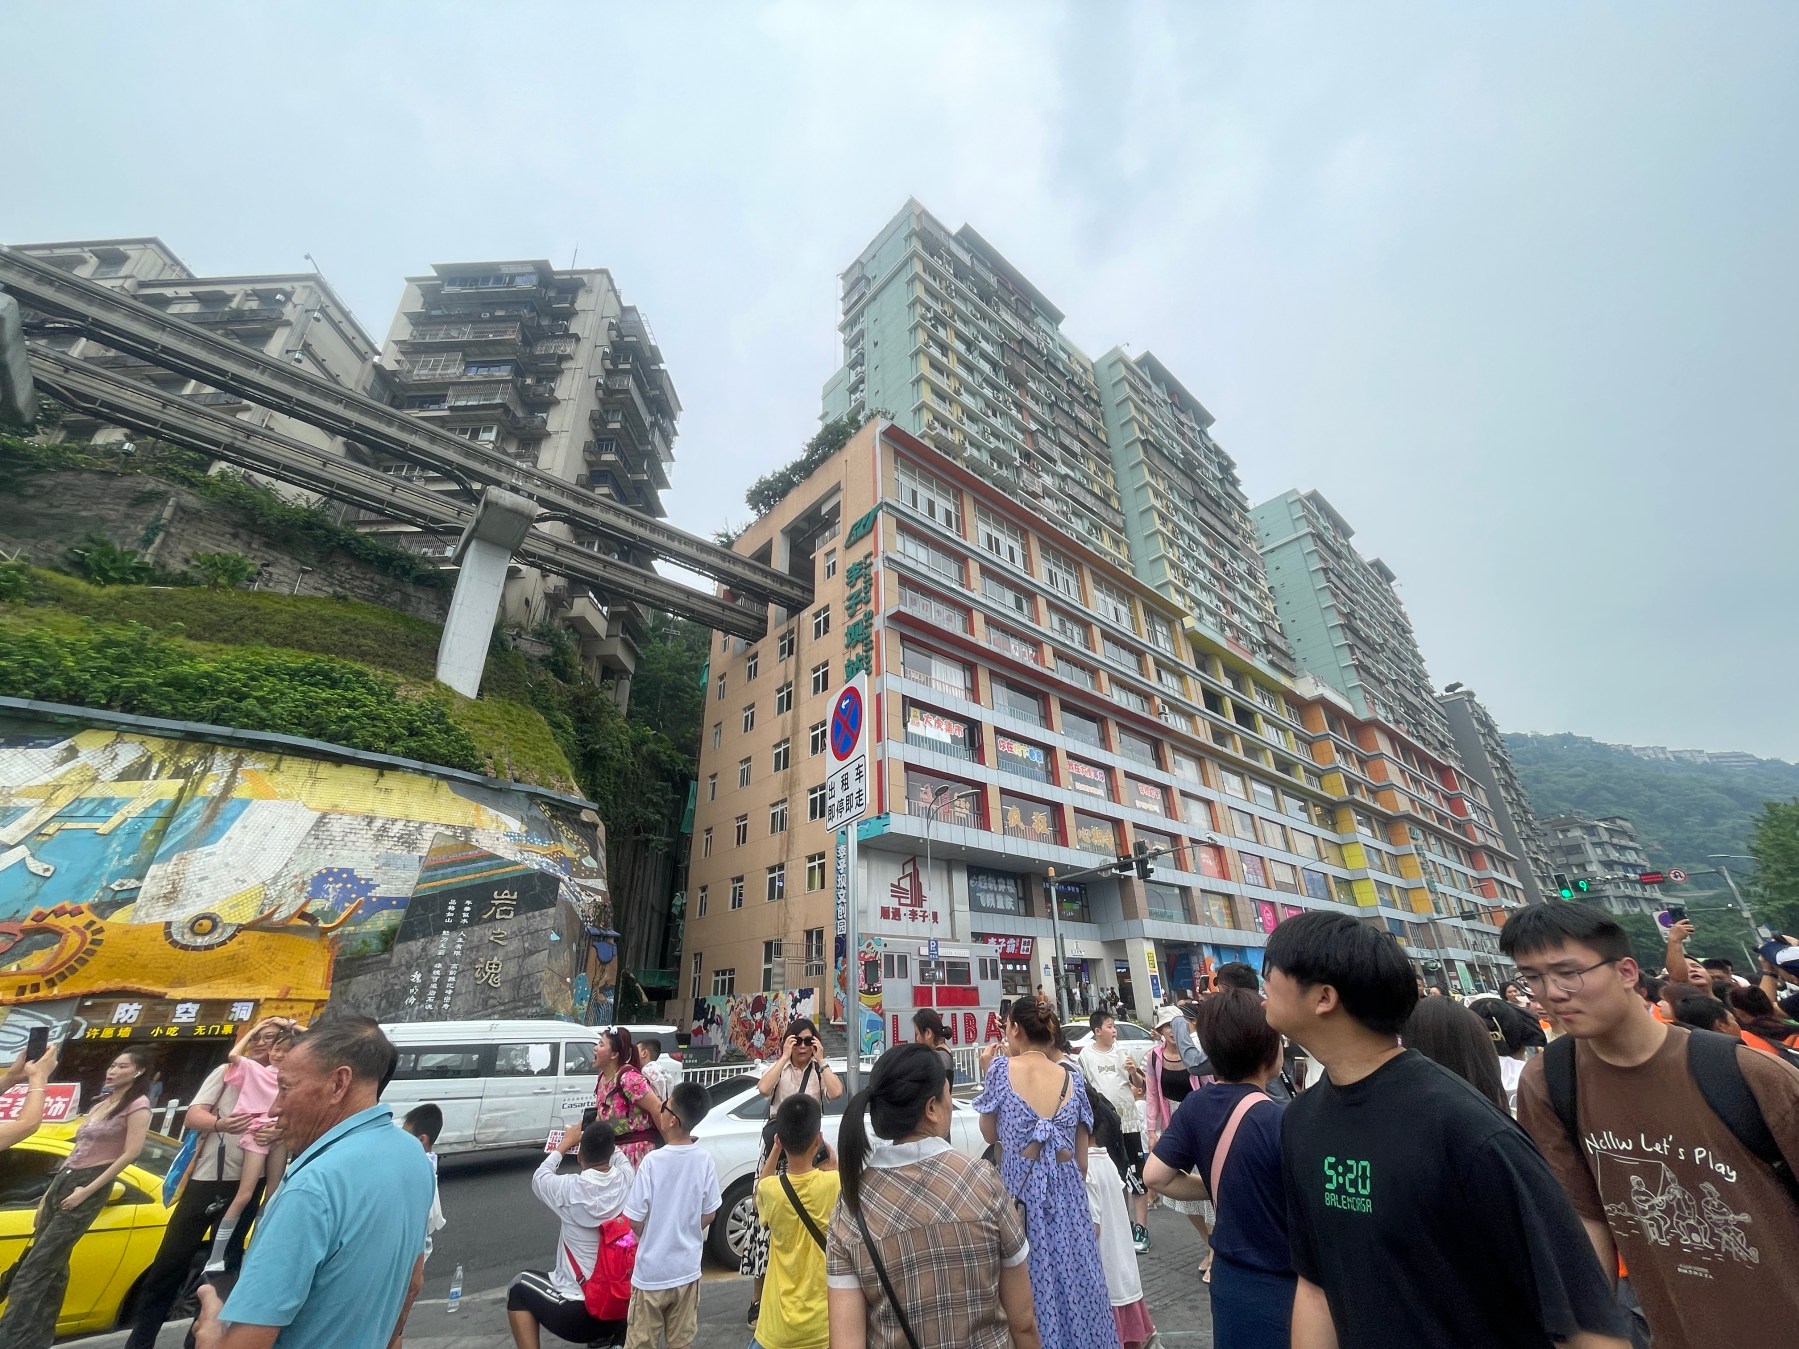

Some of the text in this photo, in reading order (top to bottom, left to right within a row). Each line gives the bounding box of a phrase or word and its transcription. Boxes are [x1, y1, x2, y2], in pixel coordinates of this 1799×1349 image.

[845, 560, 864, 685] 李子坝站
[828, 763, 864, 801] 出租车
[827, 788, 864, 823] 即停即走
[1578, 880, 1588, 892] 9
[474, 889, 518, 988] 岩之魂
[930, 941, 936, 950] P
[111, 1001, 254, 1024] 防空洞
[891, 1011, 1003, 1047] LIBA
[86, 1024, 235, 1039] 许愿墙 小吃 无门票
[1324, 1156, 1371, 1195] 5:20
[1640, 1132, 1685, 1160] Let's
[1693, 1147, 1737, 1183] Play
